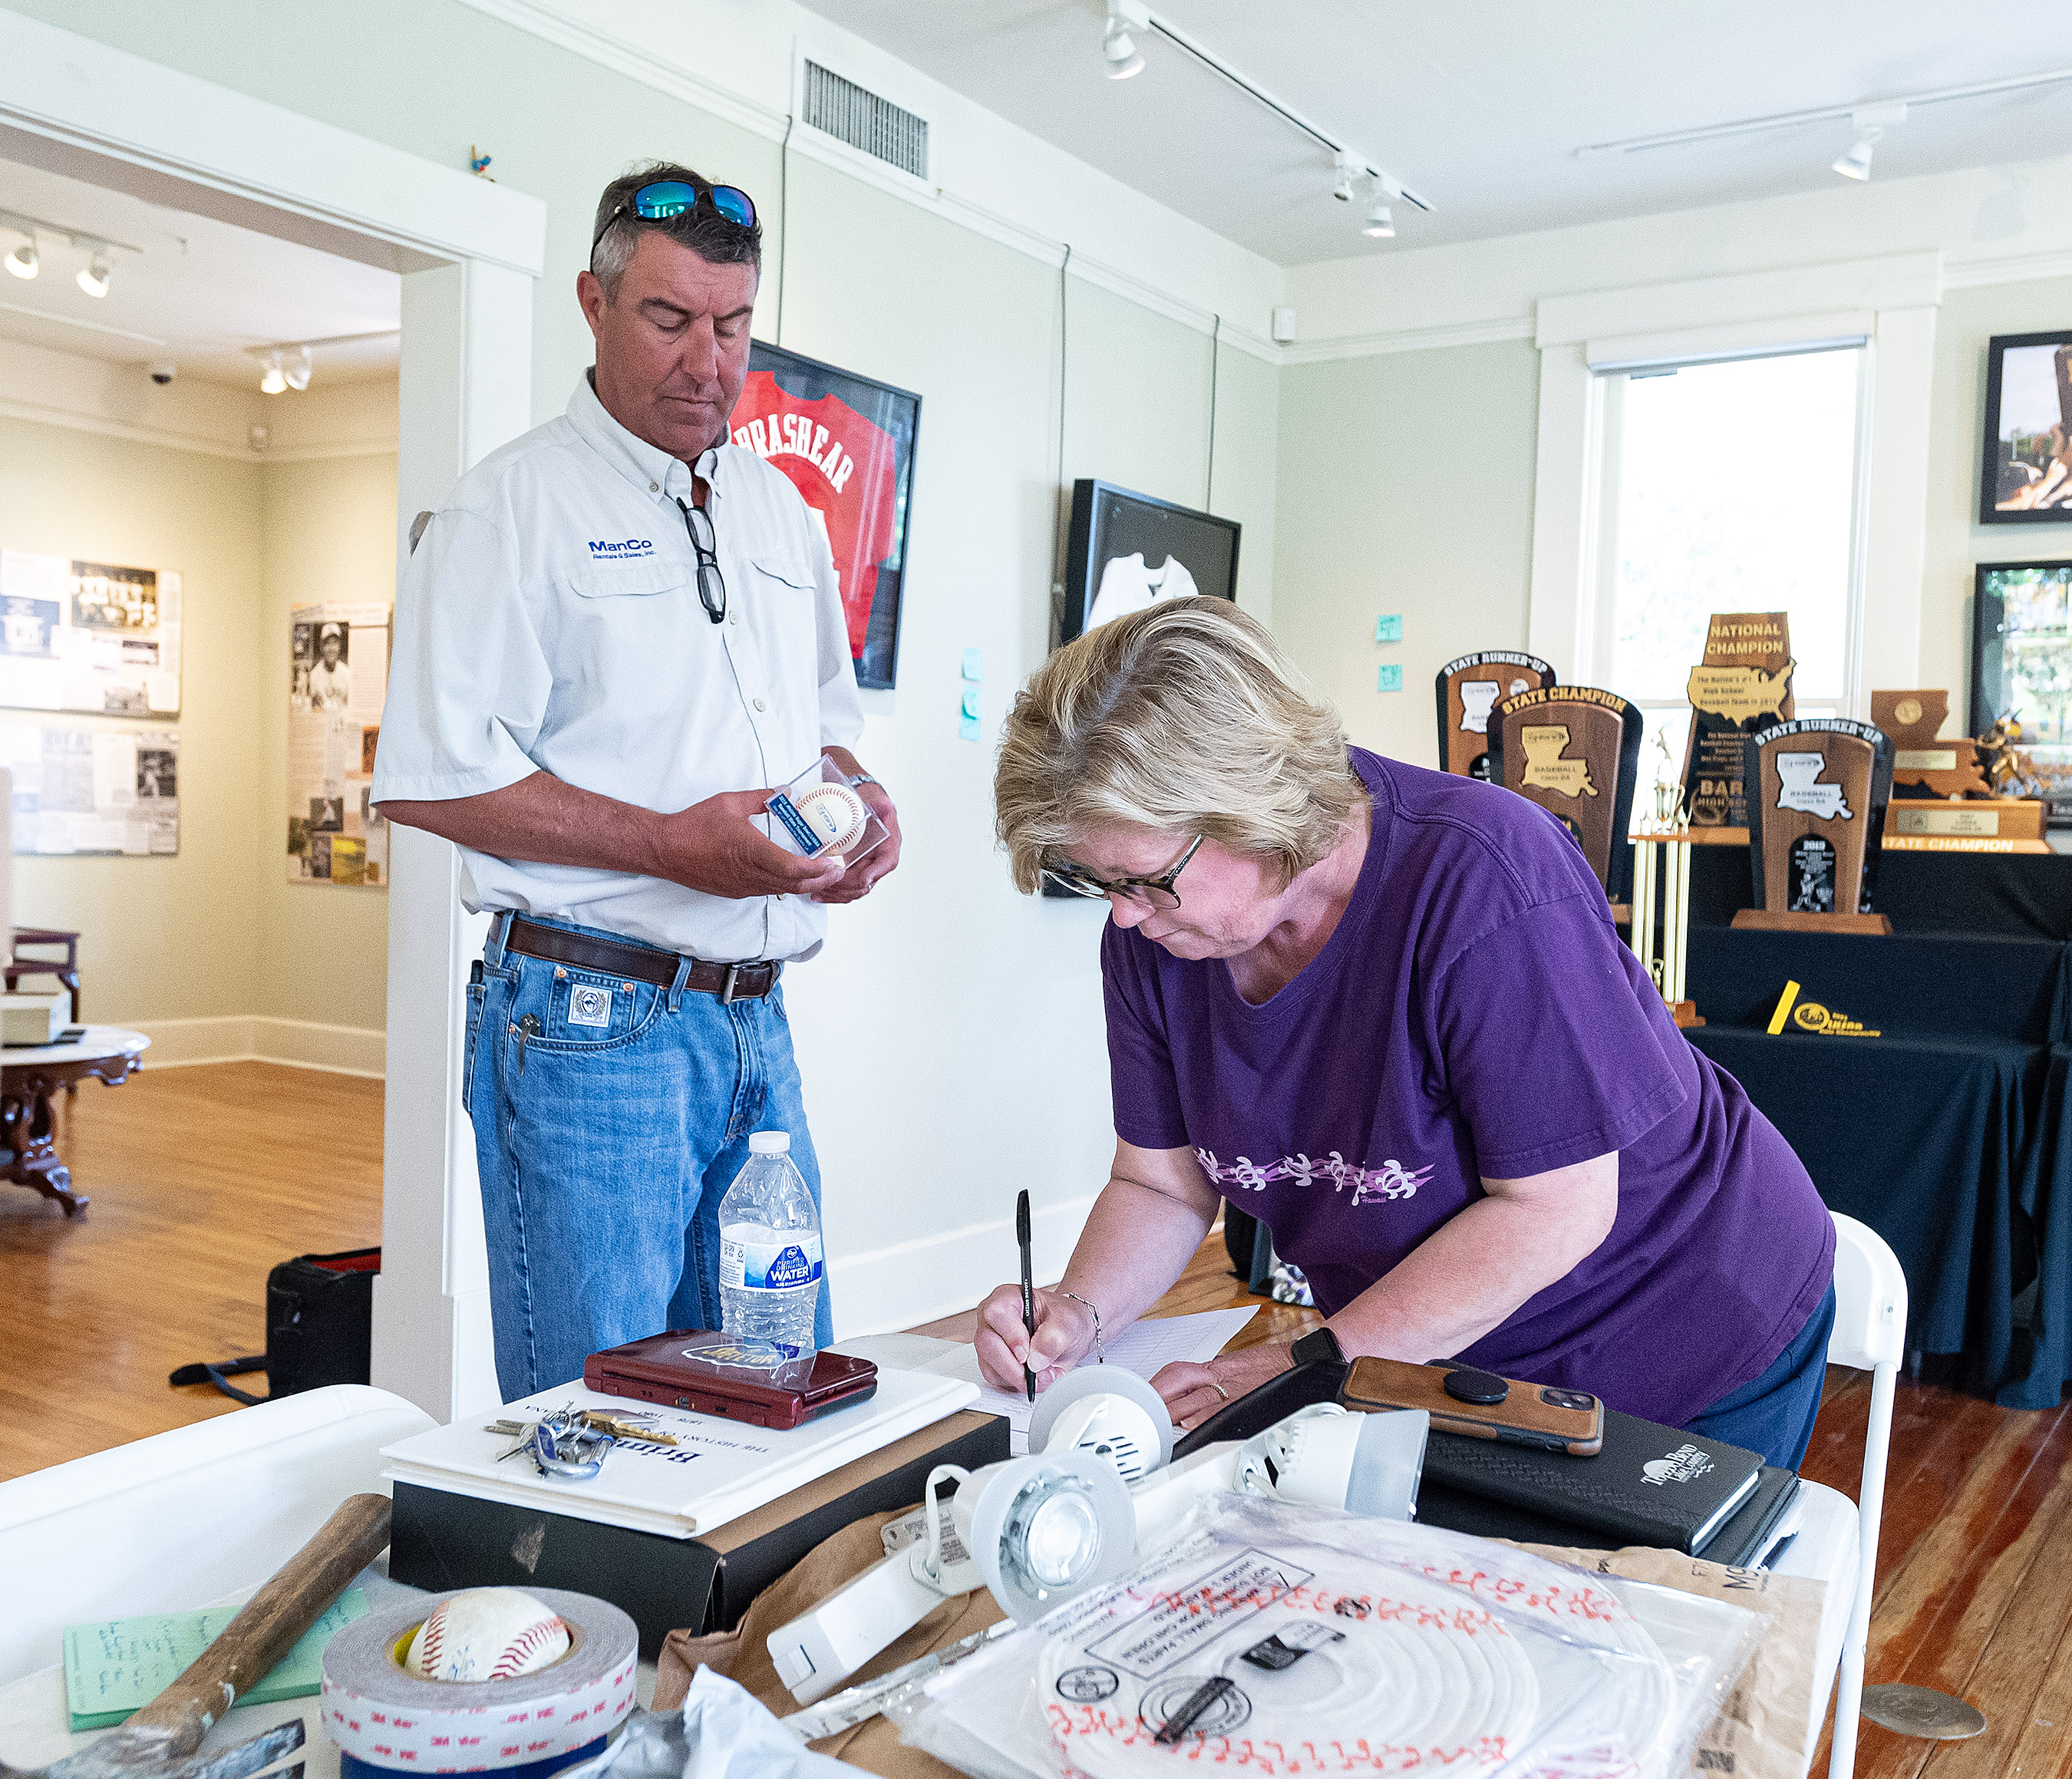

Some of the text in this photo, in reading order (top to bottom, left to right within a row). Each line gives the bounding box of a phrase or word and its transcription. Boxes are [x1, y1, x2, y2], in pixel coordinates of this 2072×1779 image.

[588, 539, 652, 552] ManCo
[1711, 623, 1781, 638] NATIONAL
[1707, 641, 1783, 655] CHAMPION
[1443, 652, 1549, 677] STATE RUNNER-UP
[1502, 687, 1627, 715] STATE CHAMPION
[1754, 719, 1884, 747] STATE RUNNER-UP
[1928, 838, 2014, 852] CHAMPION
[776, 1262, 805, 1271] DRINKING
[777, 1256, 805, 1266] PURIFIED
[770, 1266, 809, 1282] WATER
